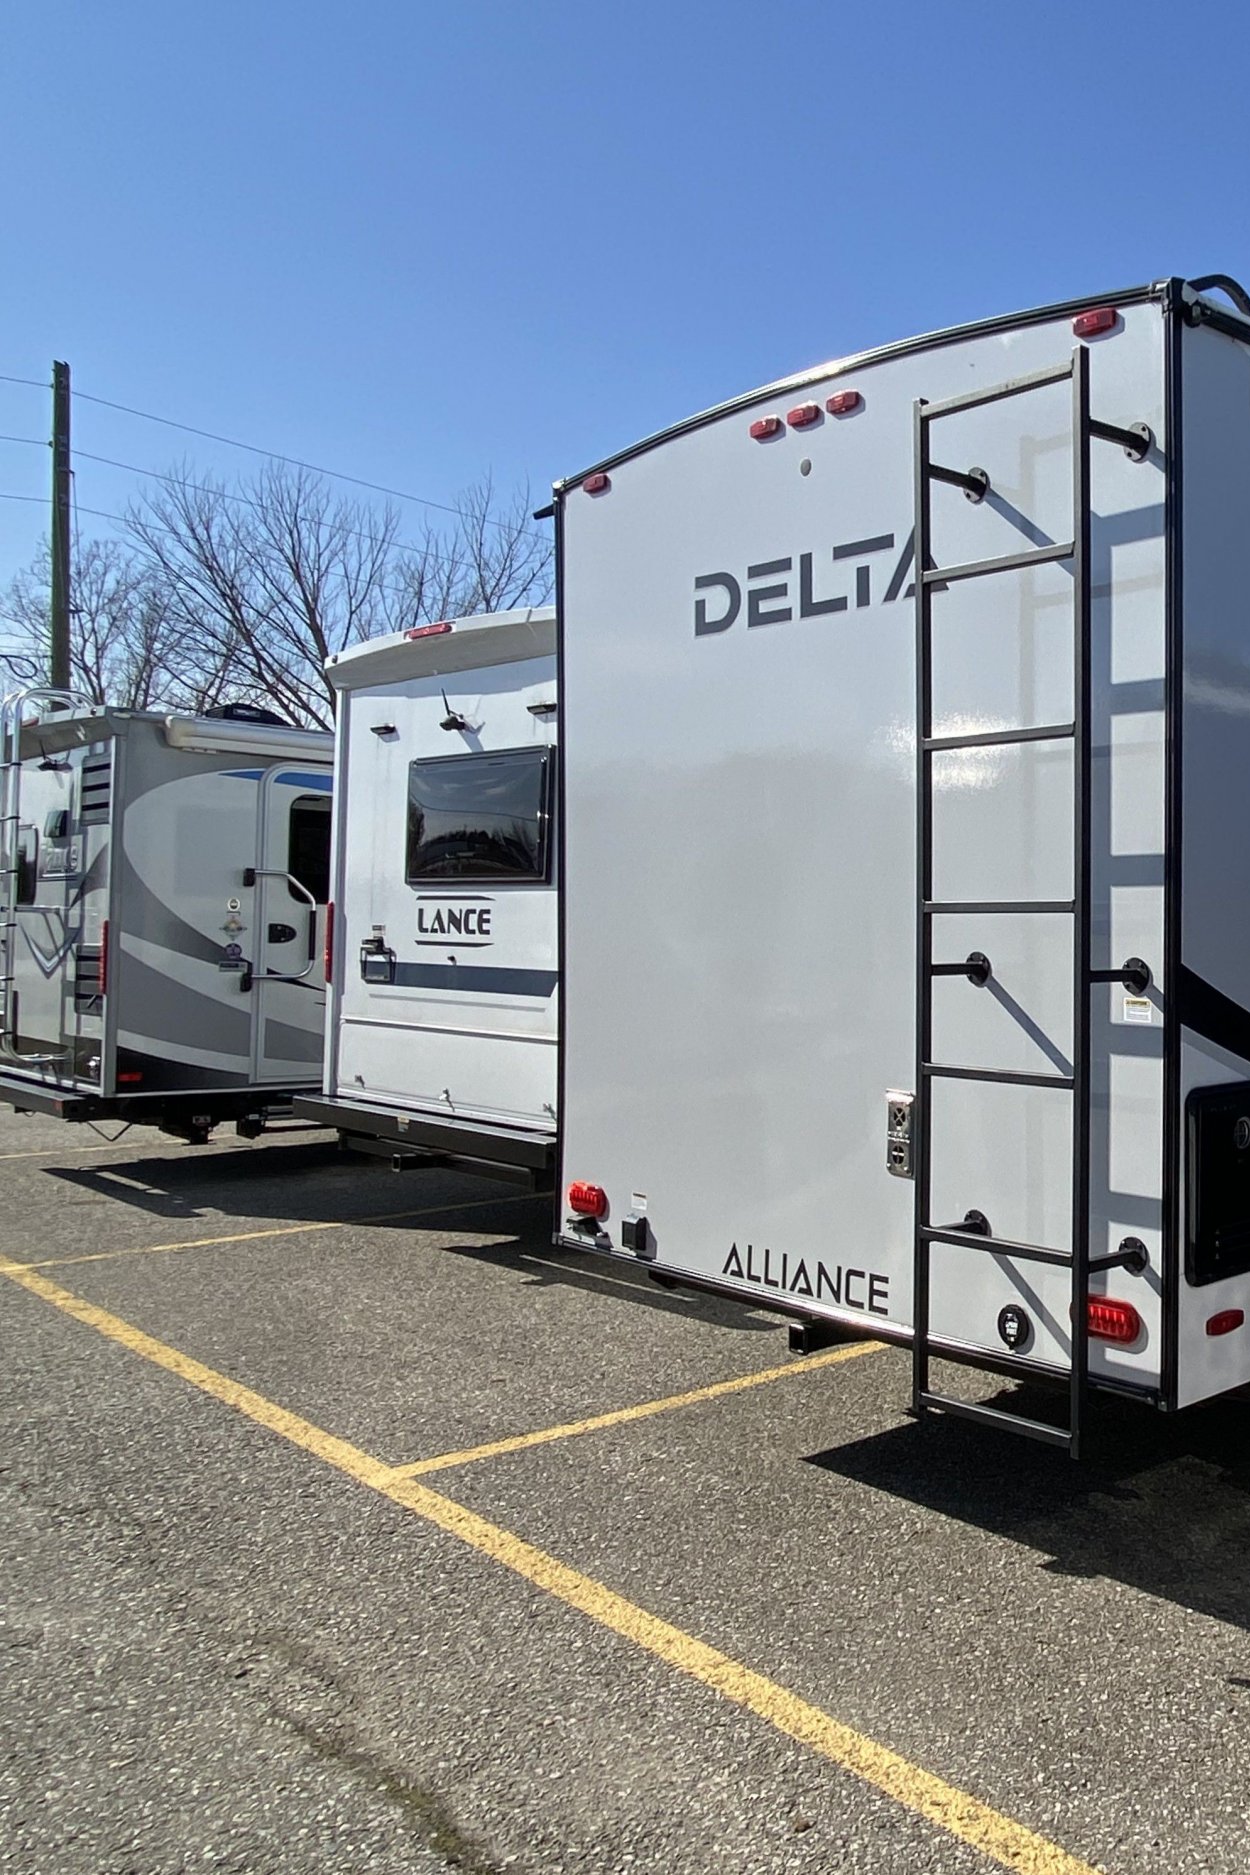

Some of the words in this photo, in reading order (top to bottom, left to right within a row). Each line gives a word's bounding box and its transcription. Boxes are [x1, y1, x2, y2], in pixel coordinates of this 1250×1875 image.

[695, 524, 949, 636] DELTA
[418, 908, 491, 935] LANCE
[722, 1242, 889, 1316] ALLIANCE
